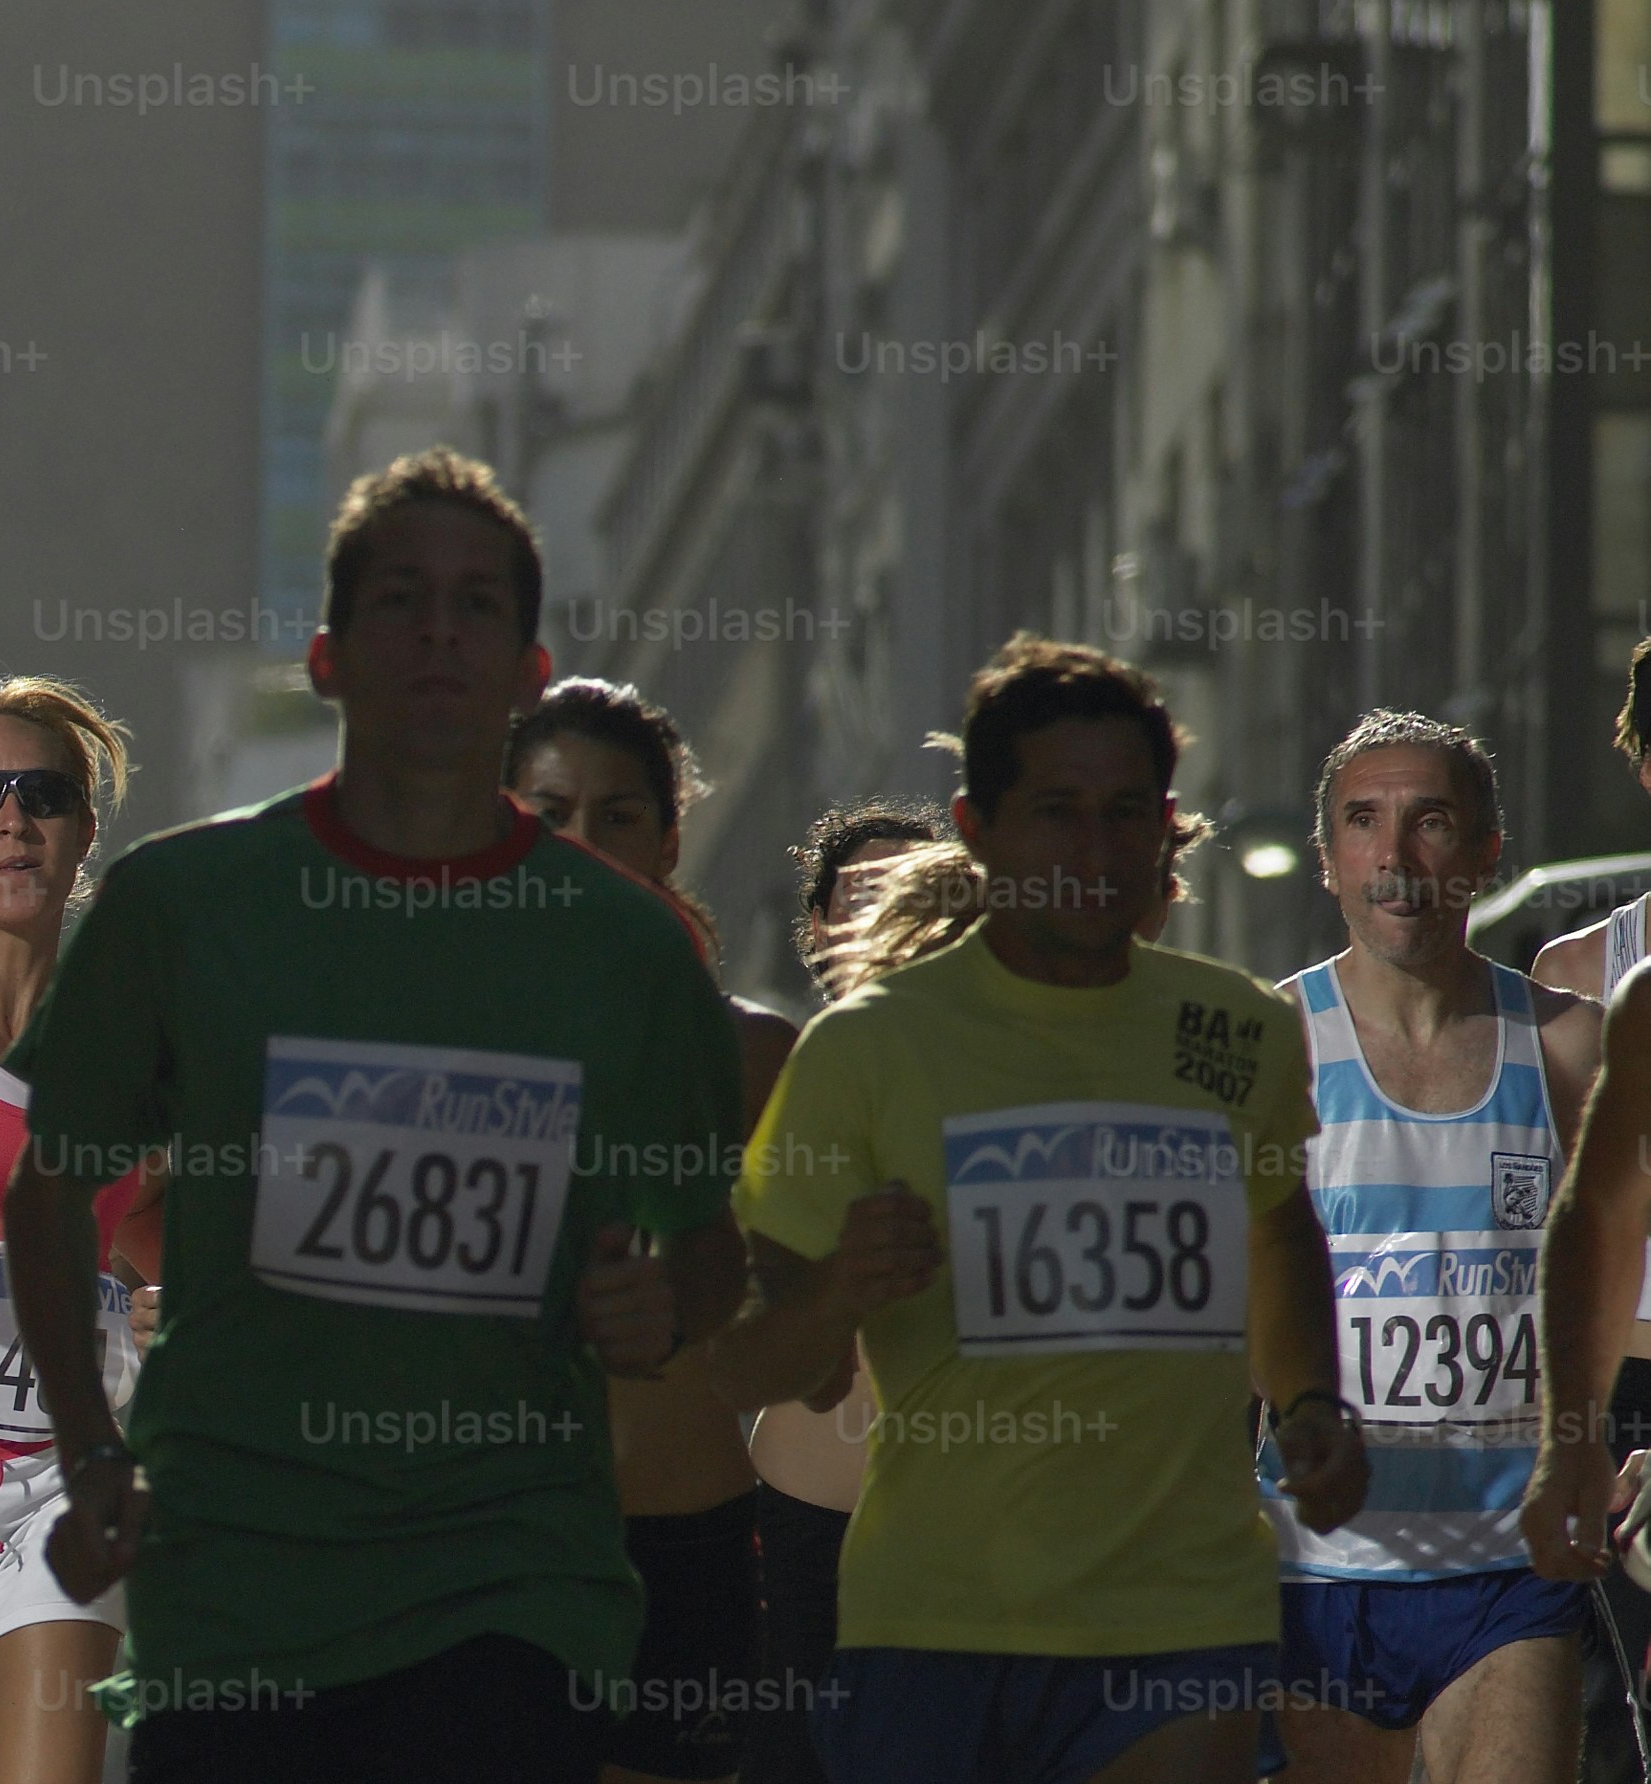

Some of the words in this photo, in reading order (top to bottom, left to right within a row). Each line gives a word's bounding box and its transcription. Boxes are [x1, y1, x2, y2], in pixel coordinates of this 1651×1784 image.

[1178, 1001, 1230, 1048] BA
[414, 1071, 580, 1141] RunStyle
[1175, 1051, 1254, 1107] 2007
[295, 1141, 539, 1276] 26831
[973, 1199, 1212, 1317] 16358
[1437, 1251, 1540, 1296] RunSty
[1351, 1313, 1541, 1407] 12394
